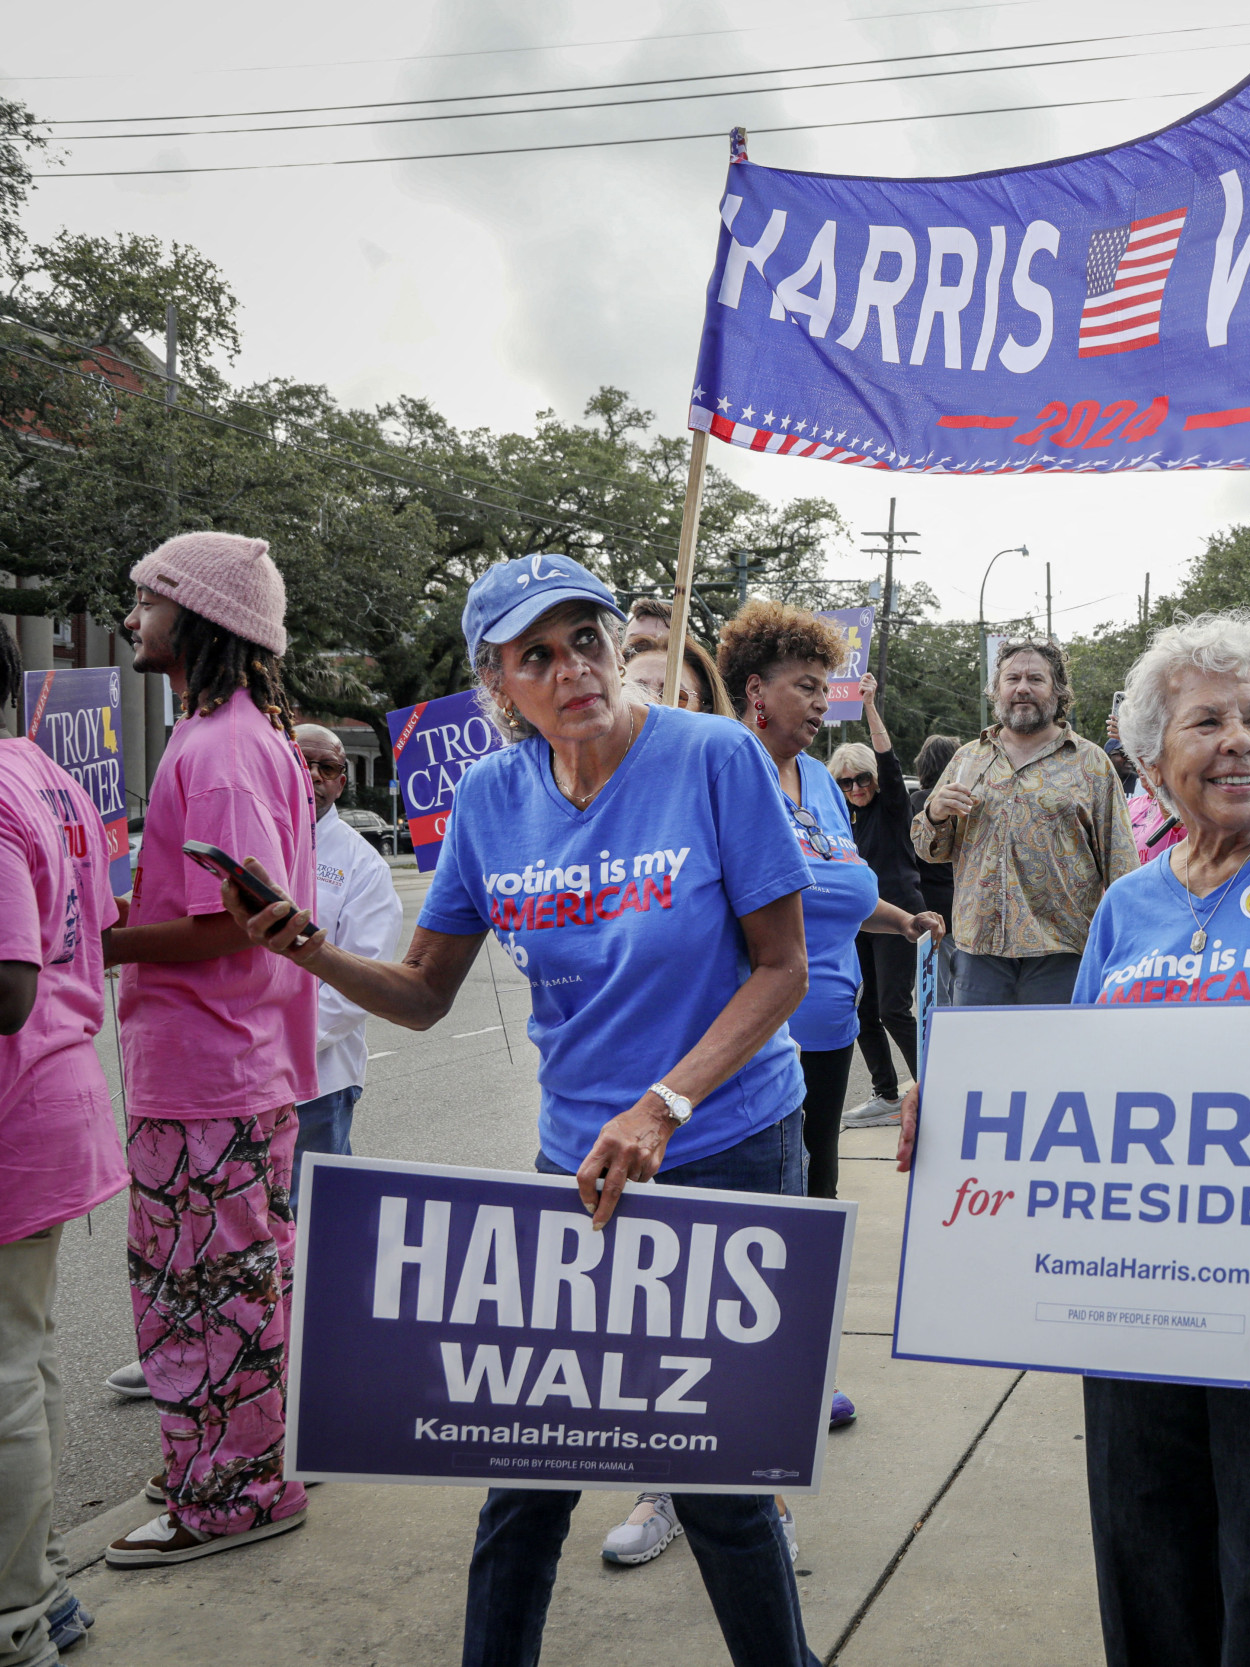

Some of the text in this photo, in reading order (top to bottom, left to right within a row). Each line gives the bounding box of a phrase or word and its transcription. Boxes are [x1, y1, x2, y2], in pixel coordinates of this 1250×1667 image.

[718, 194, 1060, 373] HARRIS
[1013, 396, 1168, 449] 2024
[46, 708, 101, 767] TROY
[396, 711, 419, 751] RE-ELECT
[317, 864, 339, 874] TROY
[483, 848, 690, 898] voting is my
[490, 875, 672, 931] AMERICAN
[1104, 949, 1203, 988] voting
[1210, 939, 1237, 972] is
[942, 1177, 1015, 1227] for
[372, 1196, 787, 1343] HARRIS
[1035, 1253, 1250, 1285] KamalaHarris.com
[1068, 1309, 1207, 1328] PAID FOR BY PEOPLE FOR KAMALA
[440, 1342, 712, 1414] WALZ
[415, 1417, 718, 1451] KamalaHarris.com
[490, 1457, 634, 1471] PAID FOR BY PEOPLE FOR KAMALA
